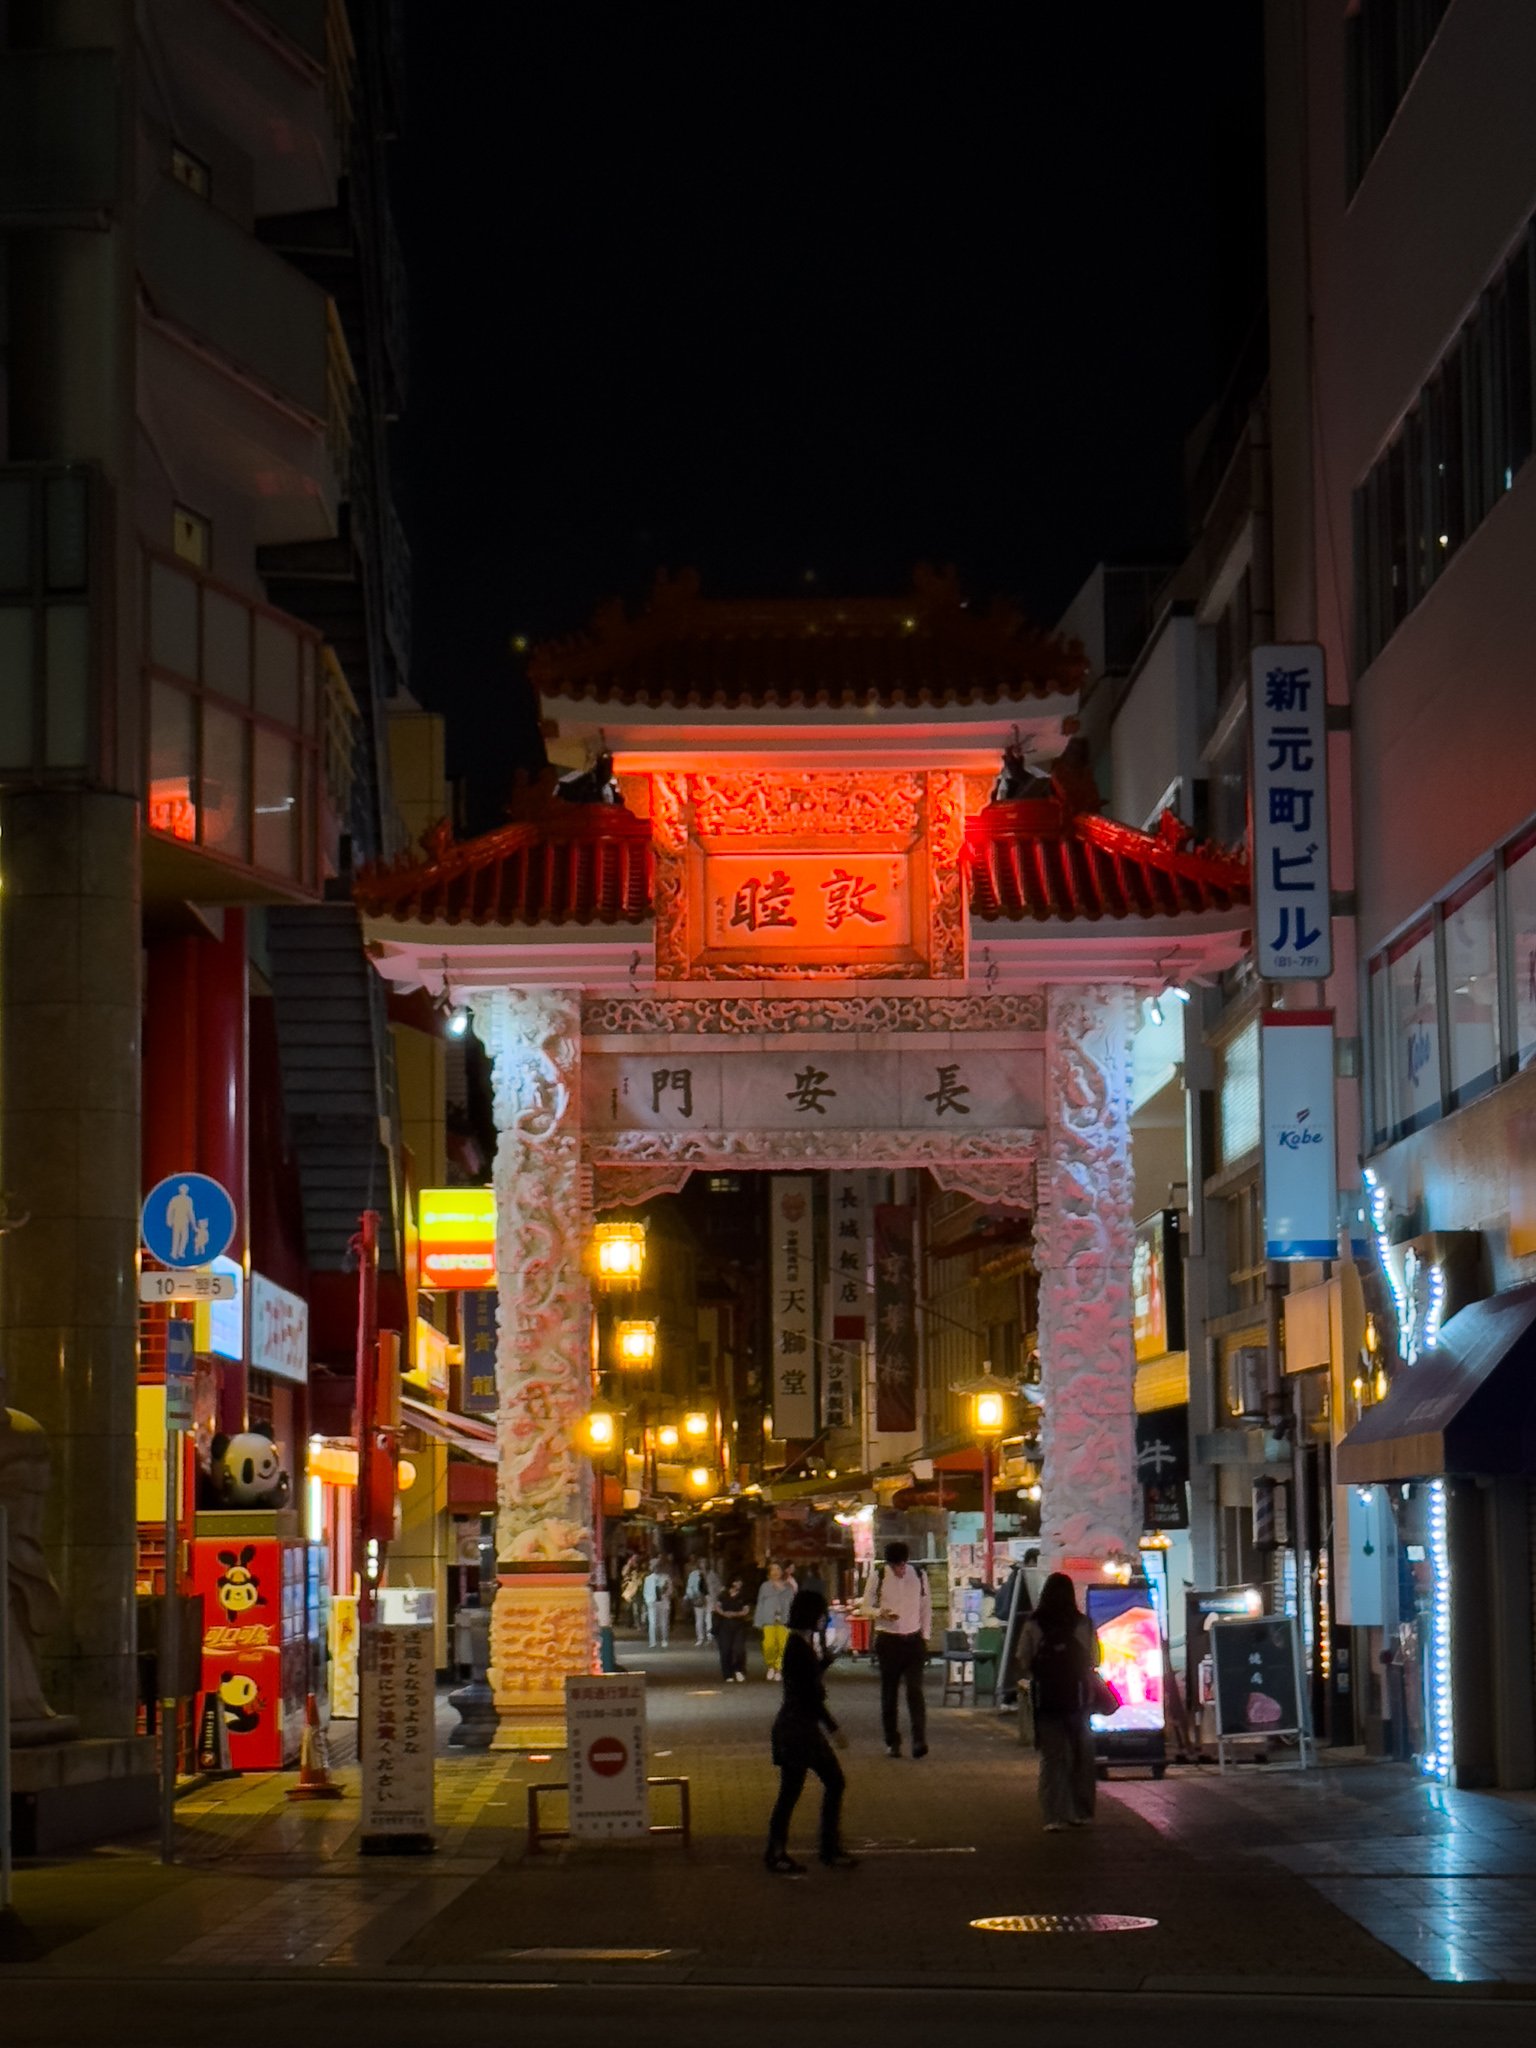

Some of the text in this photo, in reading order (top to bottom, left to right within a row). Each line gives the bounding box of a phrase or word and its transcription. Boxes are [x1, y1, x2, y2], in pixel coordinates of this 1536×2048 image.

[1265, 666, 1322, 951] 新元町ビル
[1279, 1129, 1323, 1150] Kobe
[838, 1186, 860, 1304] 長城飯店
[779, 1288, 808, 1396] 天獅堂
